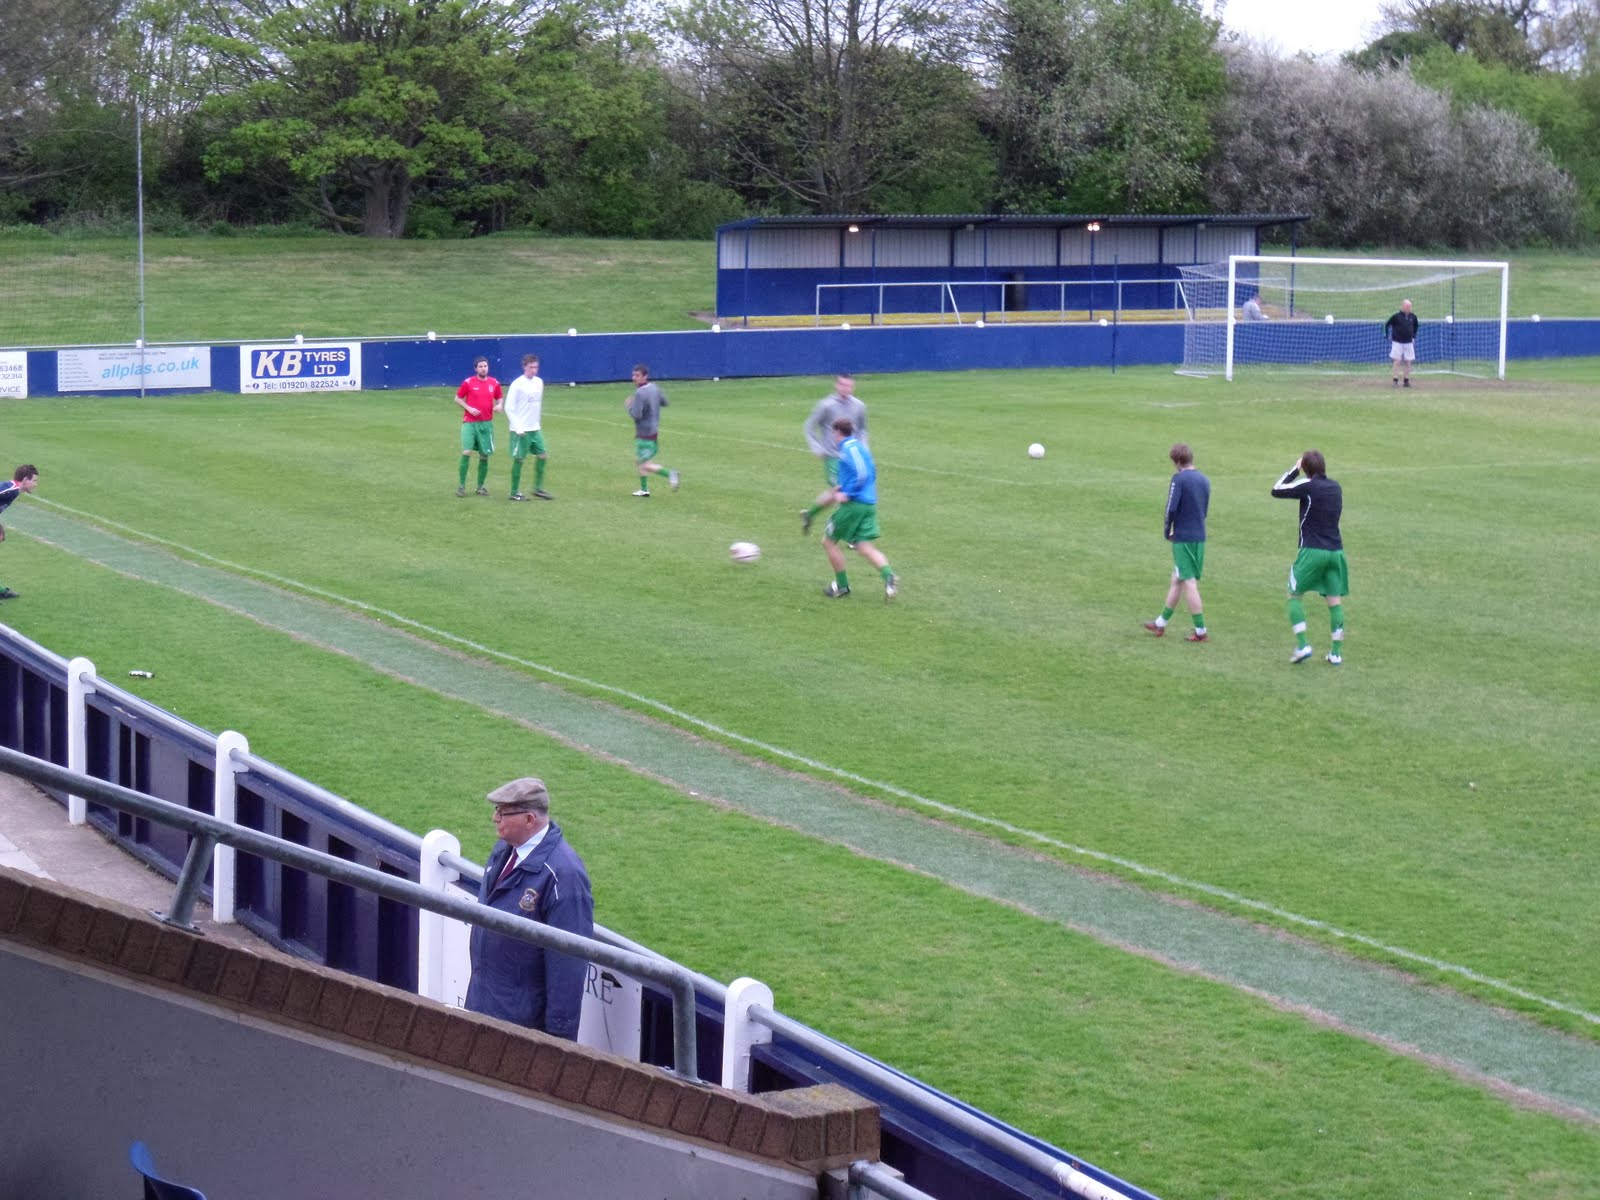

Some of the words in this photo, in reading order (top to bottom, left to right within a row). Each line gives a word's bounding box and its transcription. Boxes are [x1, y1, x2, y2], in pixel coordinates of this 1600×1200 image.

[304, 351, 346, 362] TYRES
[102, 356, 199, 379] allplas.co.uk
[255, 350, 302, 376] KB
[313, 365, 337, 375] LTD
[280, 381, 307, 389] (01920)
[310, 380, 339, 388] 822524
